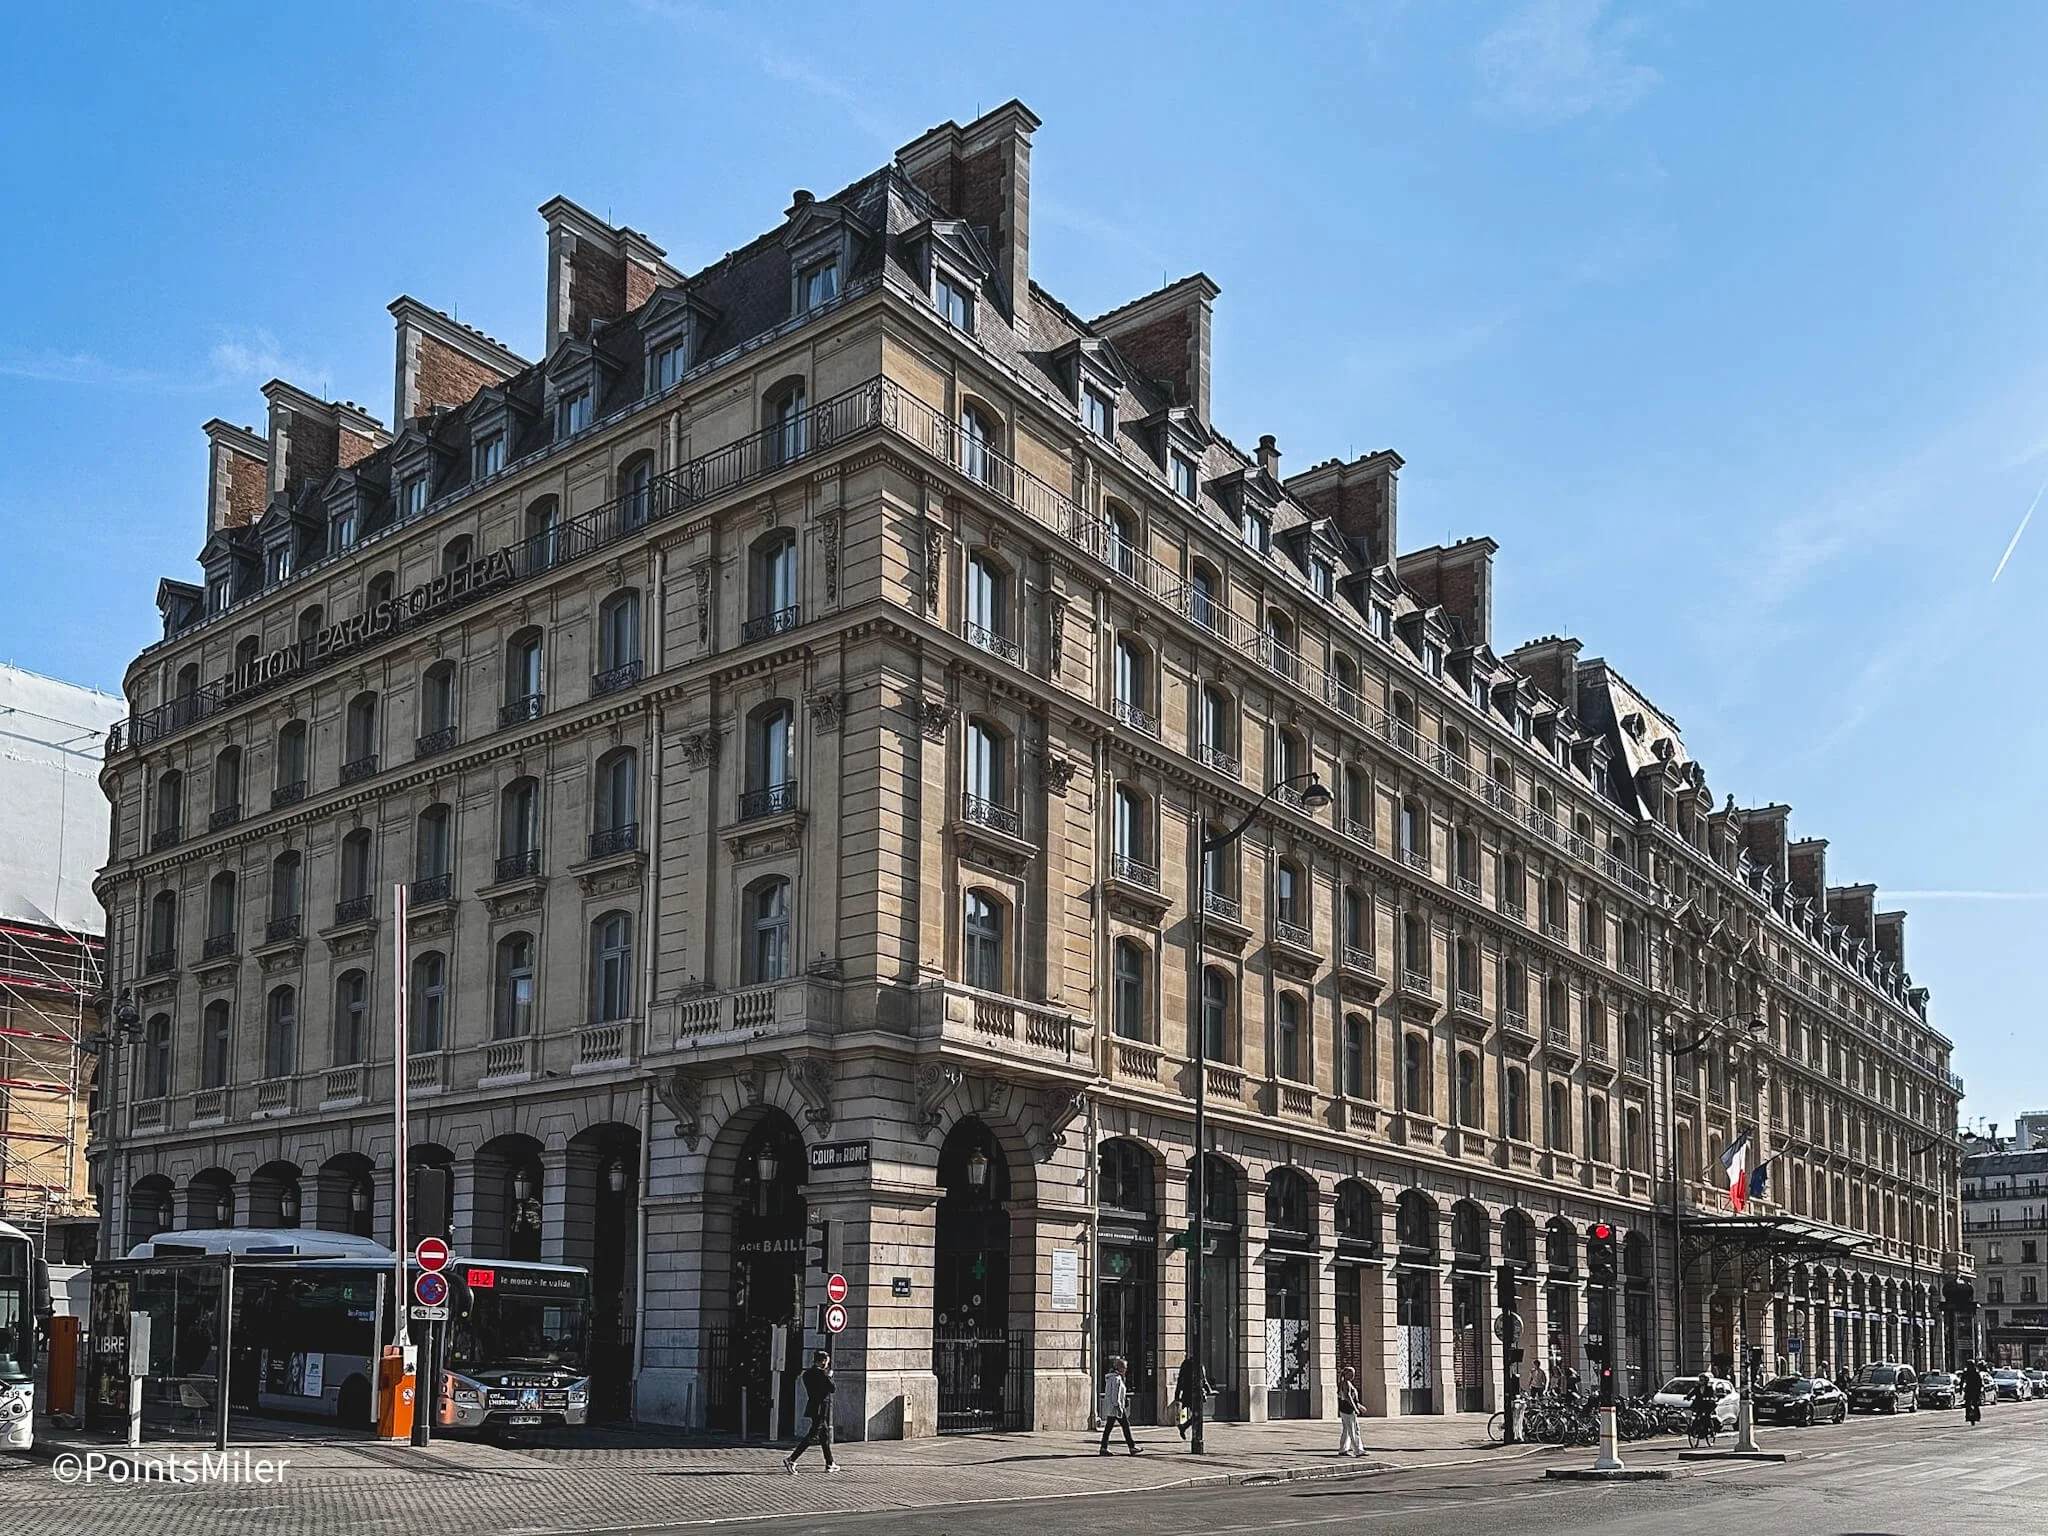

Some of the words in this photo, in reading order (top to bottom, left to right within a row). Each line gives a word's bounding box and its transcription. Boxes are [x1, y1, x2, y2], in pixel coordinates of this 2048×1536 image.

[222, 643, 301, 696] HILTON
[317, 602, 392, 653] PARIS
[812, 1149, 835, 1165] COUR
[843, 1145, 868, 1162] ROME
[472, 1271, 490, 1286] 42
[95, 1336, 125, 1353] LIBRE
